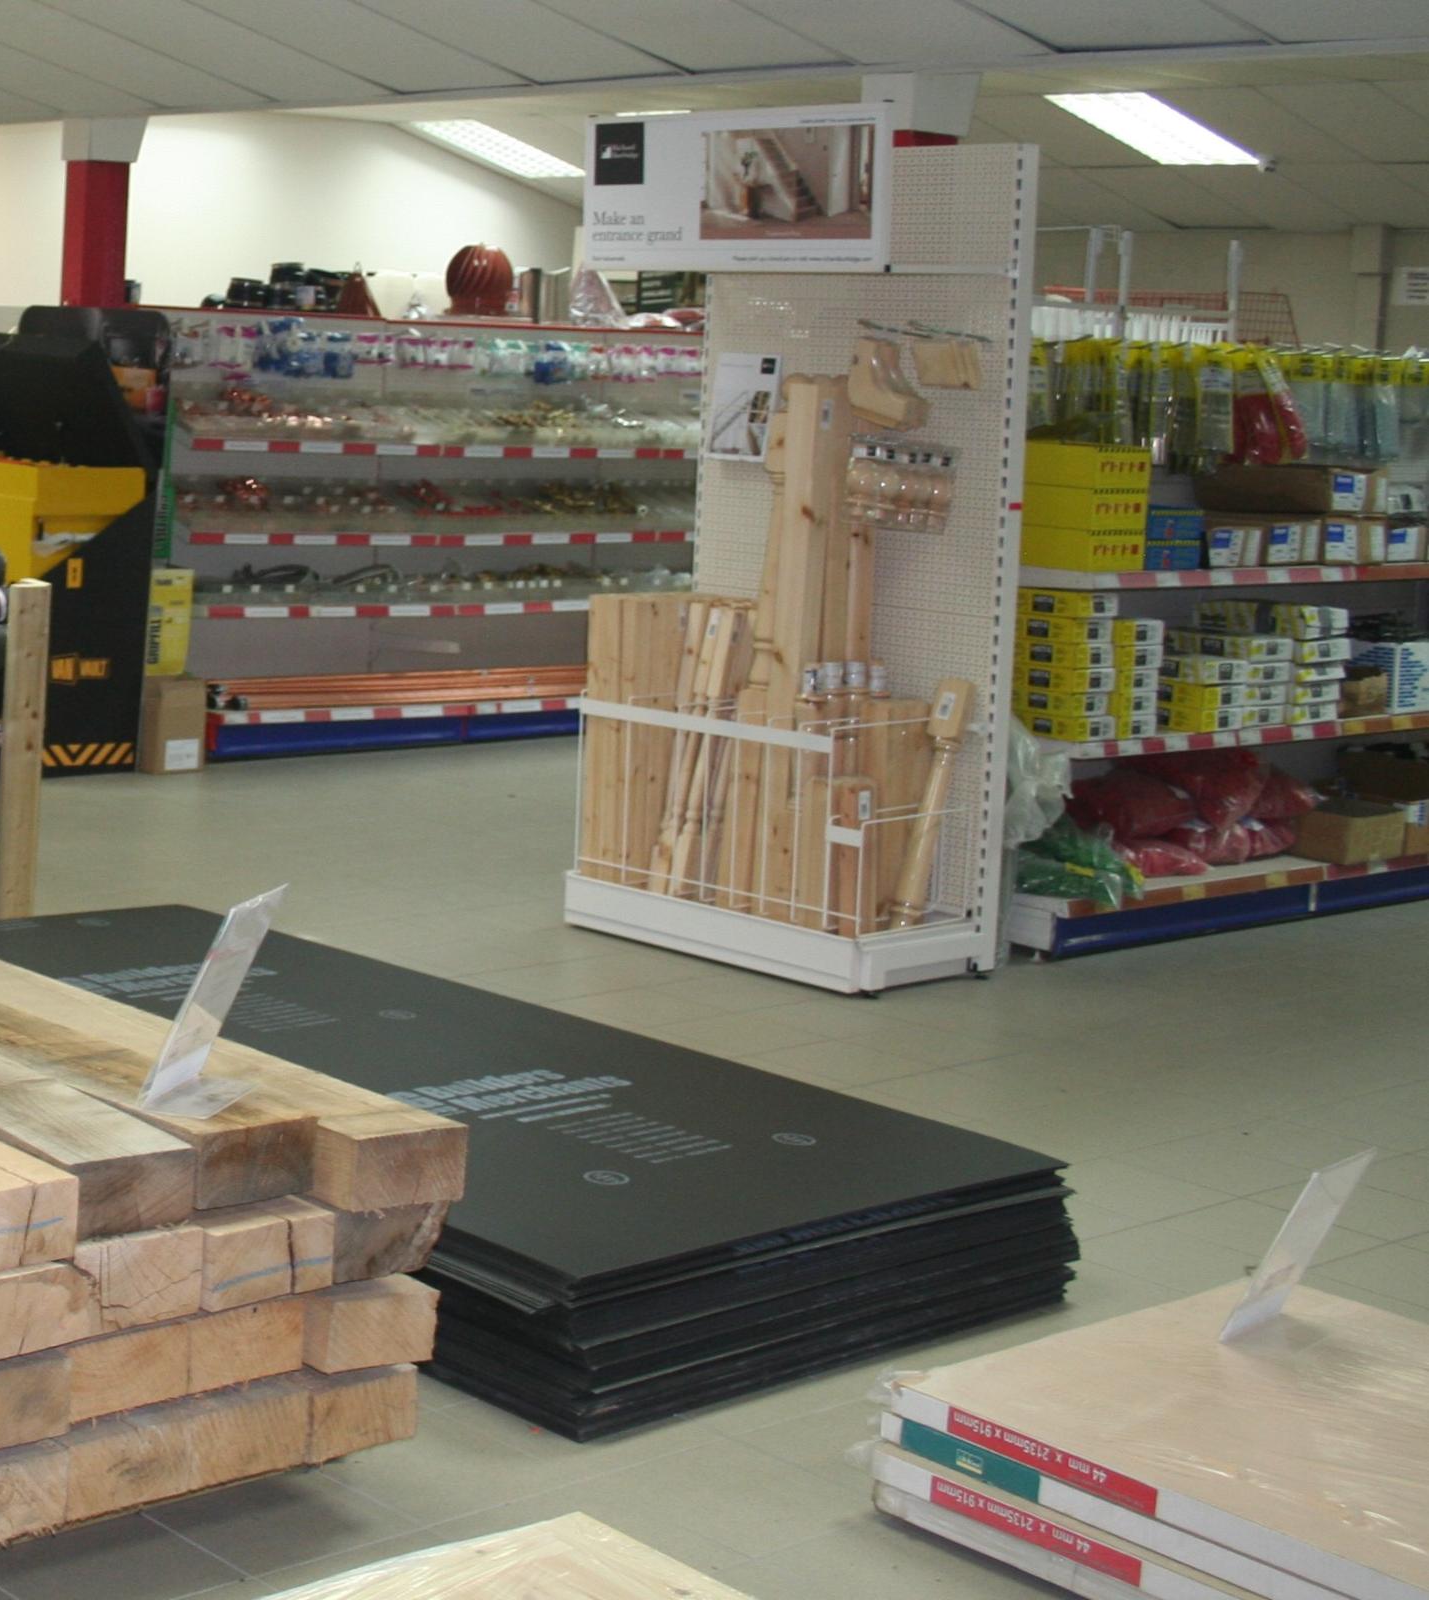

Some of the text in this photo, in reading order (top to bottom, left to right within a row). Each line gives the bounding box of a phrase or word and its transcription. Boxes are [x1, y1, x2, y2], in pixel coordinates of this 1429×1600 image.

[593, 211, 645, 225] Make an
[592, 226, 683, 246] entrance grand
[413, 1069, 566, 1100] Builders
[448, 1075, 633, 1112] Merchants
[954, 1411, 992, 1437] 915mm
[1003, 1432, 1050, 1461] 2135mm
[1068, 1457, 1090, 1474] mm
[1092, 1468, 1107, 1484] 44
[936, 1481, 974, 1507] 915mm
[987, 1502, 1034, 1531] 2135mm
[1052, 1527, 1074, 1545] mm
[1076, 1538, 1091, 1553] 44
